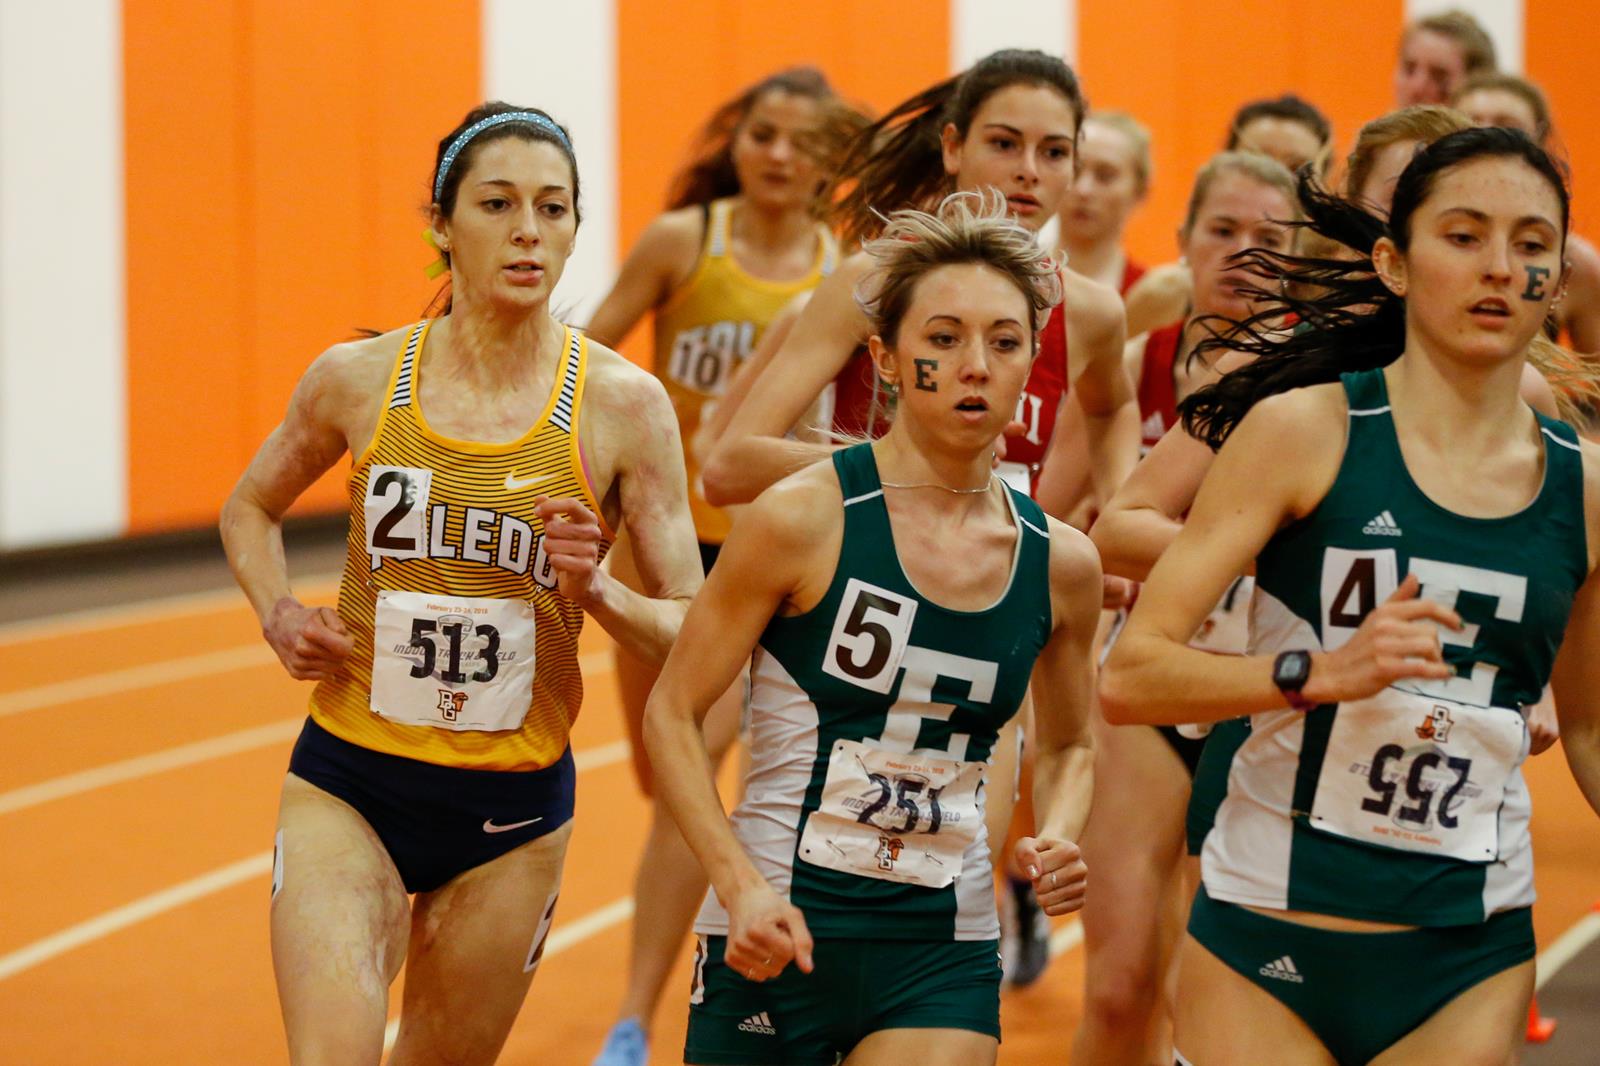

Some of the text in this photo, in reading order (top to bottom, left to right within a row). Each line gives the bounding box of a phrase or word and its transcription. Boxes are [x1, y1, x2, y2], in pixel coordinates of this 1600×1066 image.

[1521, 265, 1550, 301] E
[913, 358, 938, 393] E
[372, 471, 416, 551] 2
[1362, 526, 1402, 537] adidas
[1329, 558, 1376, 628] 4
[409, 618, 500, 684] 513
[835, 590, 902, 680] 5
[1398, 557, 1528, 709] E
[862, 644, 999, 761] E
[857, 773, 945, 834] 251
[1361, 743, 1473, 829] 255
[1259, 967, 1304, 983] adidas
[737, 1023, 776, 1036] adidas
